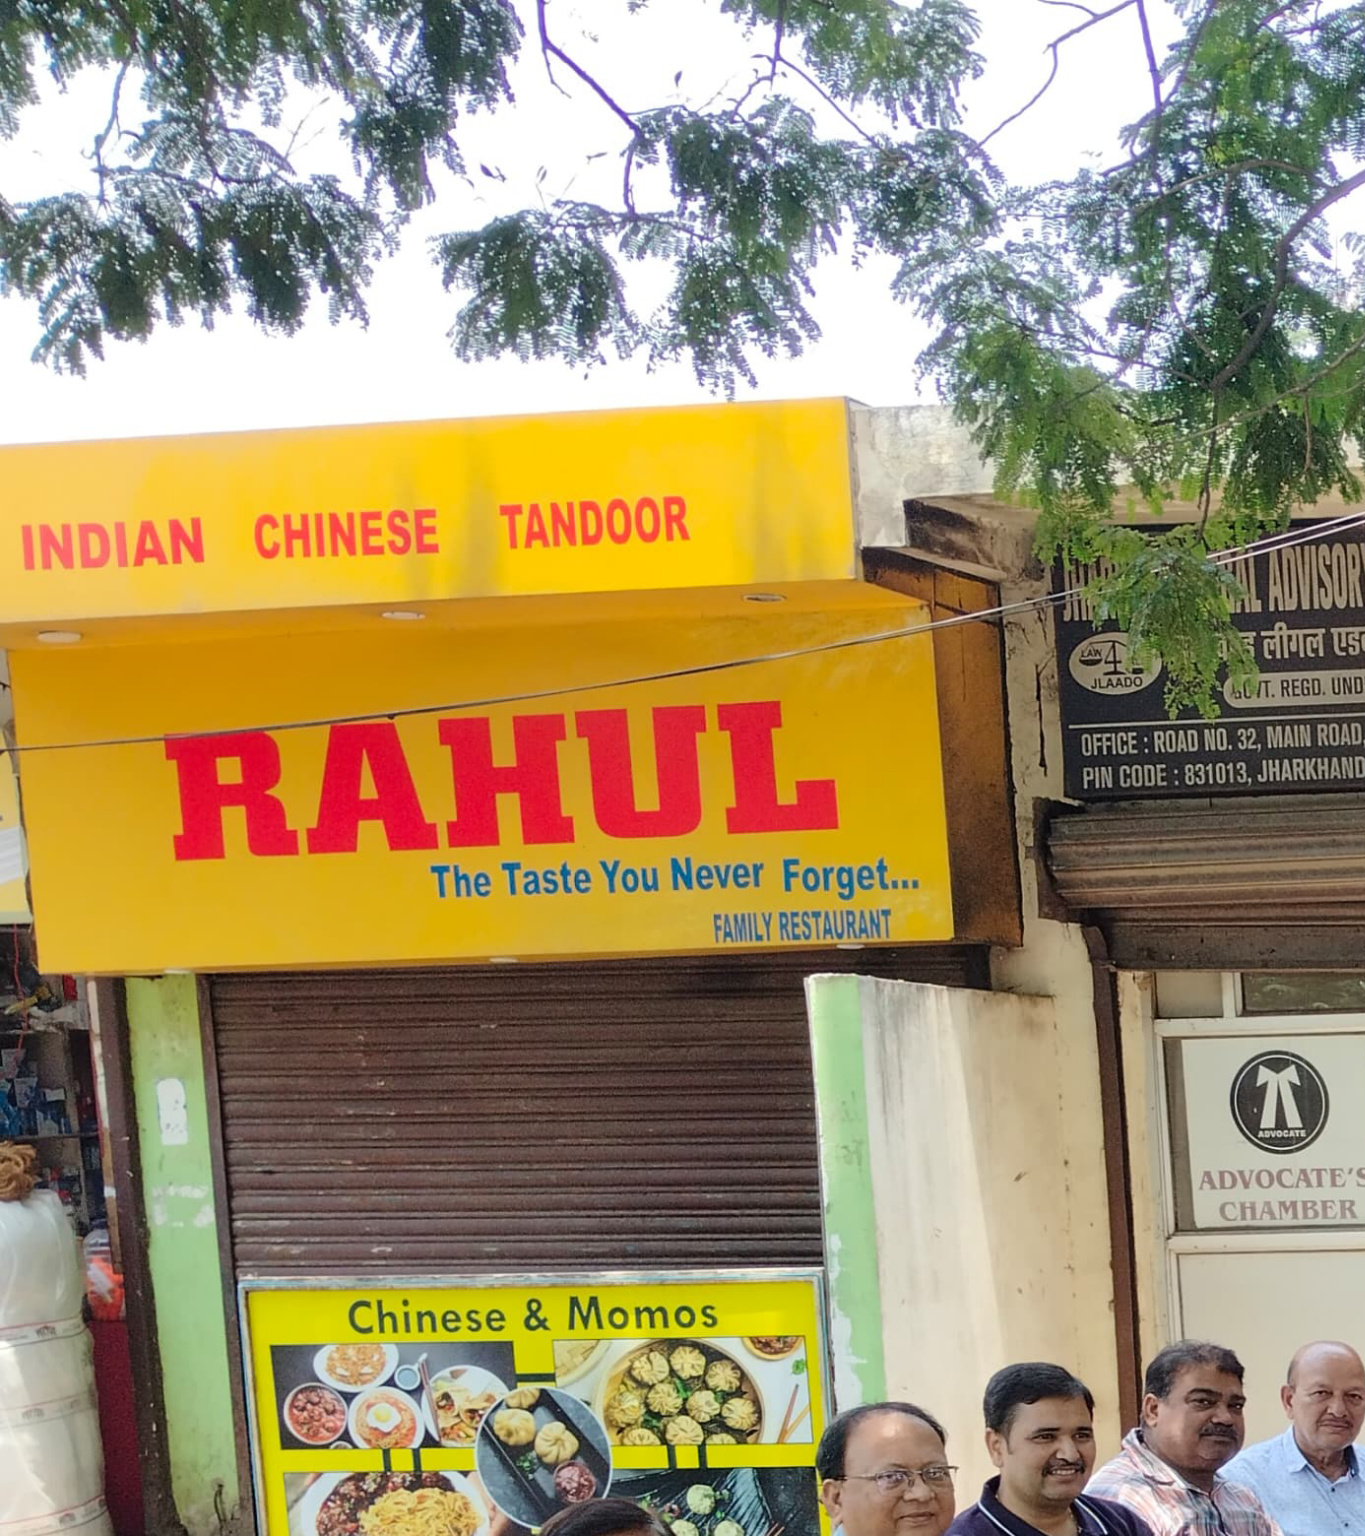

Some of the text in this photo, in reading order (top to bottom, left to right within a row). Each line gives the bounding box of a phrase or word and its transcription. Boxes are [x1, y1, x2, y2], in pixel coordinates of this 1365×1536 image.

[21, 495, 690, 571] INDIAN CHINESE TANDOOR
[1261, 622, 1326, 659] लीगल
[1091, 676, 1143, 689] JLAADO
[1281, 678, 1326, 697] REGD.
[1082, 732, 1139, 757] OFFICE
[1154, 728, 1199, 753] ROAD
[1205, 727, 1232, 751] NO.
[1238, 726, 1261, 753] 32,
[1267, 724, 1312, 749] MAIN
[164, 700, 839, 861] RAHUL
[1083, 766, 1112, 789] PIN
[1120, 764, 1167, 788] CODE
[1185, 763, 1252, 787] 831013,
[430, 857, 921, 902] The Taste You Never Forget...
[713, 909, 892, 945] FAMILY RESTAURANT
[1258, 1129, 1307, 1138] ADVOCATE
[1219, 1199, 1357, 1221] CHAMBER
[349, 1296, 719, 1334] Chinese & Momos
